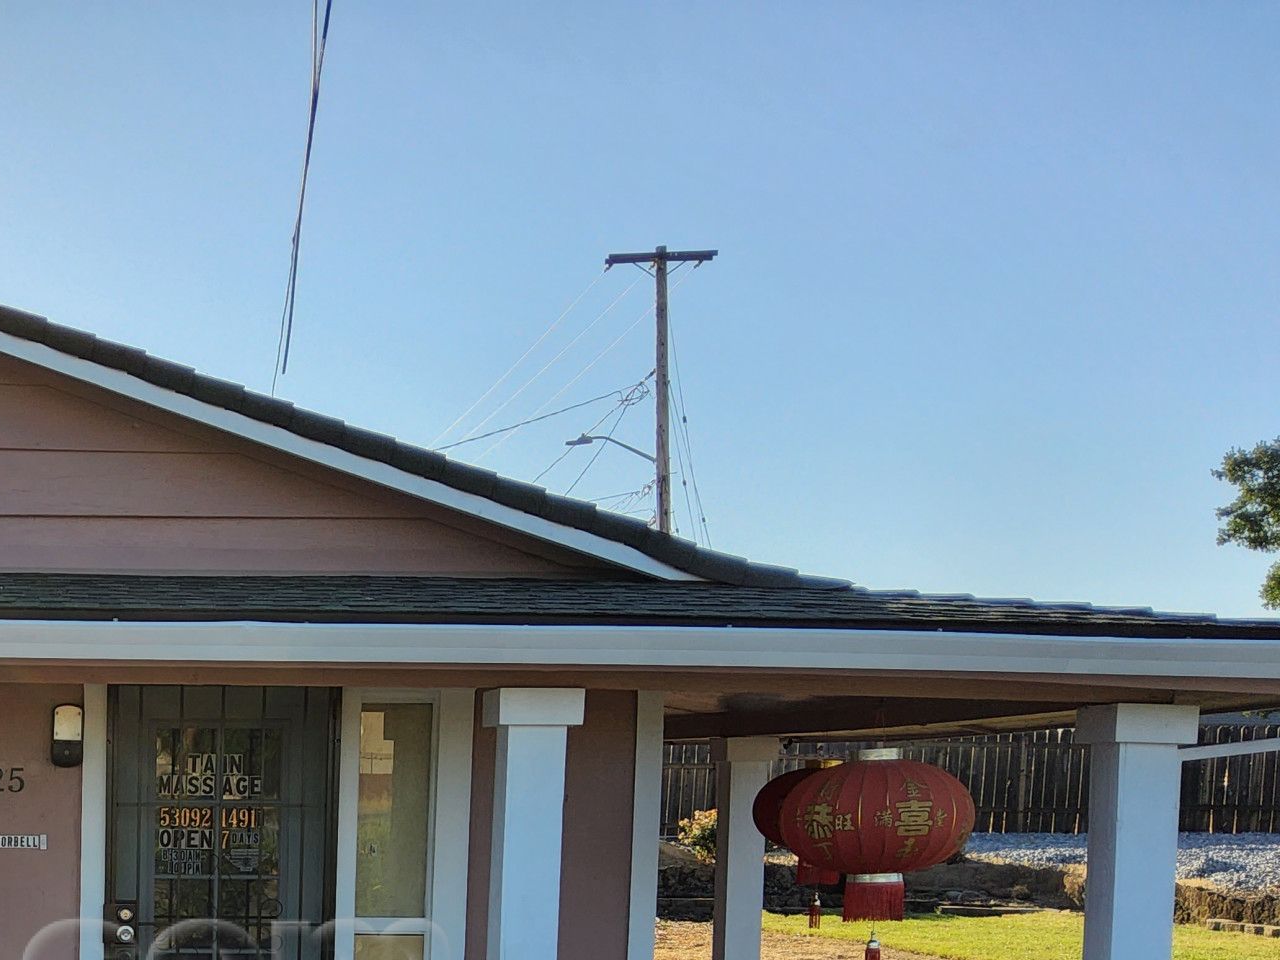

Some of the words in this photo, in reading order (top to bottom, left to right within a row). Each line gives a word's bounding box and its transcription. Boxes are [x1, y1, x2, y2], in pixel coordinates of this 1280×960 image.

[894, 800, 934, 837] 喜
[160, 830, 212, 849] OPEN
[221, 831, 230, 849] 7
[232, 833, 260, 844] DAYS
